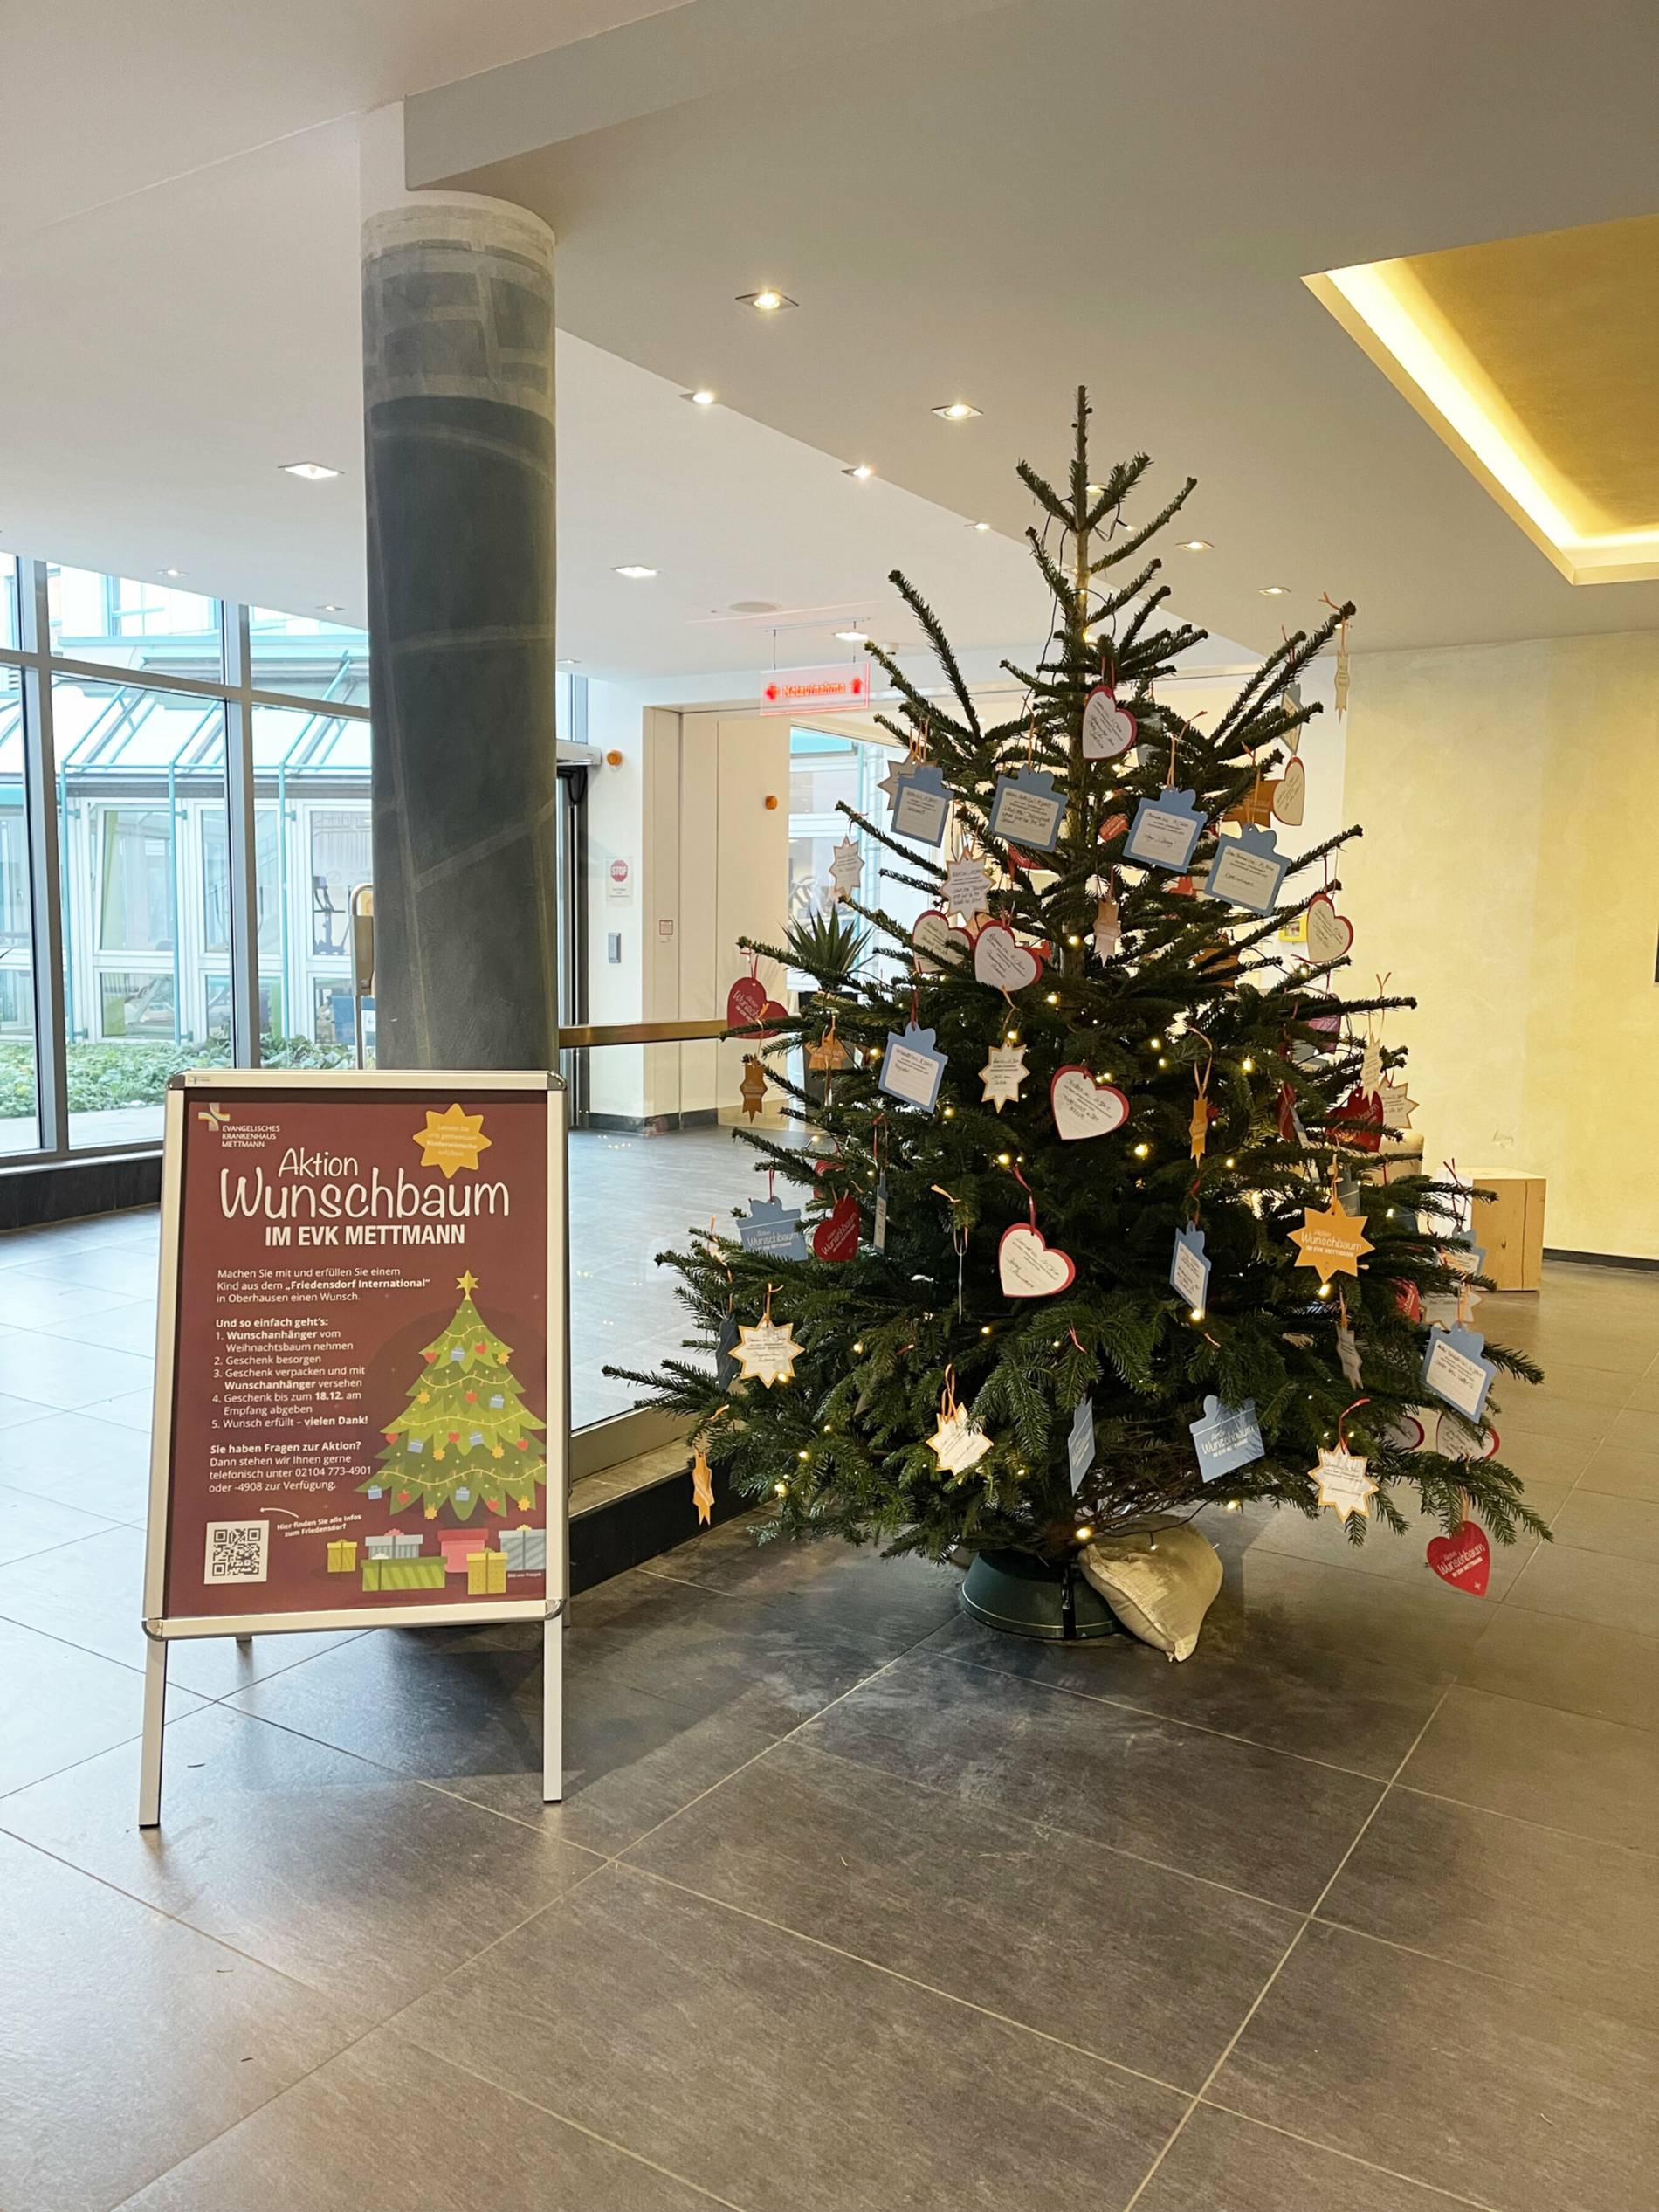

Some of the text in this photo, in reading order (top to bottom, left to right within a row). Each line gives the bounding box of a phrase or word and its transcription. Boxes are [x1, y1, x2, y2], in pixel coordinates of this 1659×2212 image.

[278, 1147, 359, 1178] Aktion
[220, 1166, 510, 1219] Wunschbaum
[265, 1224, 465, 1246] IM EVK METTMANN
[747, 1231, 799, 1247] Wunschbaum
[1300, 1230, 1362, 1251] Wunschbaum
[217, 1267, 401, 1278] Machen Sie mit und erfüllen Sie einem
[217, 1281, 239, 1291] Kind
[260, 1281, 283, 1290] dem
[216, 1292, 361, 1303] in Oberhausen einen Wunsch.
[216, 1319, 237, 1328] Und
[253, 1318, 293, 1327] einfach
[215, 1332, 224, 1340] 1.
[226, 1330, 318, 1340] Wunschanhänger
[225, 1341, 354, 1353] Weihnachtsbaum nehmen
[213, 1355, 321, 1366] 2. Geschenk besorgen
[212, 1365, 366, 1378] 3. Geschenk verpacken und mit
[224, 1378, 362, 1390] Wunschanhänger versehen
[211, 1394, 222, 1403] 4.
[224, 1393, 272, 1403] Geschenk
[274, 1392, 290, 1402] bis
[314, 1391, 344, 1401] 18.12.
[224, 1404, 313, 1416] Empfang abgeben
[211, 1419, 220, 1429] 5.
[223, 1418, 262, 1428] Wunsch
[265, 1417, 294, 1427] erfüllt
[304, 1416, 335, 1426] vielen
[338, 1416, 368, 1425] Dank!
[210, 1444, 226, 1454] Sie
[228, 1444, 262, 1453] haben
[264, 1443, 300, 1454] Fragen
[321, 1441, 361, 1451] Aktion?
[210, 1455, 352, 1467] Dann stehen wir Ihnen gerne
[210, 1465, 371, 1480] telefonisch unter 02104 773-4901
[209, 1483, 232, 1492] oder
[234, 1482, 263, 1492] -4908
[283, 1479, 336, 1492] Verfügung.
[293, 1519, 317, 1528] finden
[343, 1513, 362, 1522] Infos
[301, 1522, 347, 1535] Friedensdorf
[1437, 1543, 1486, 1575] Wunschbaum
